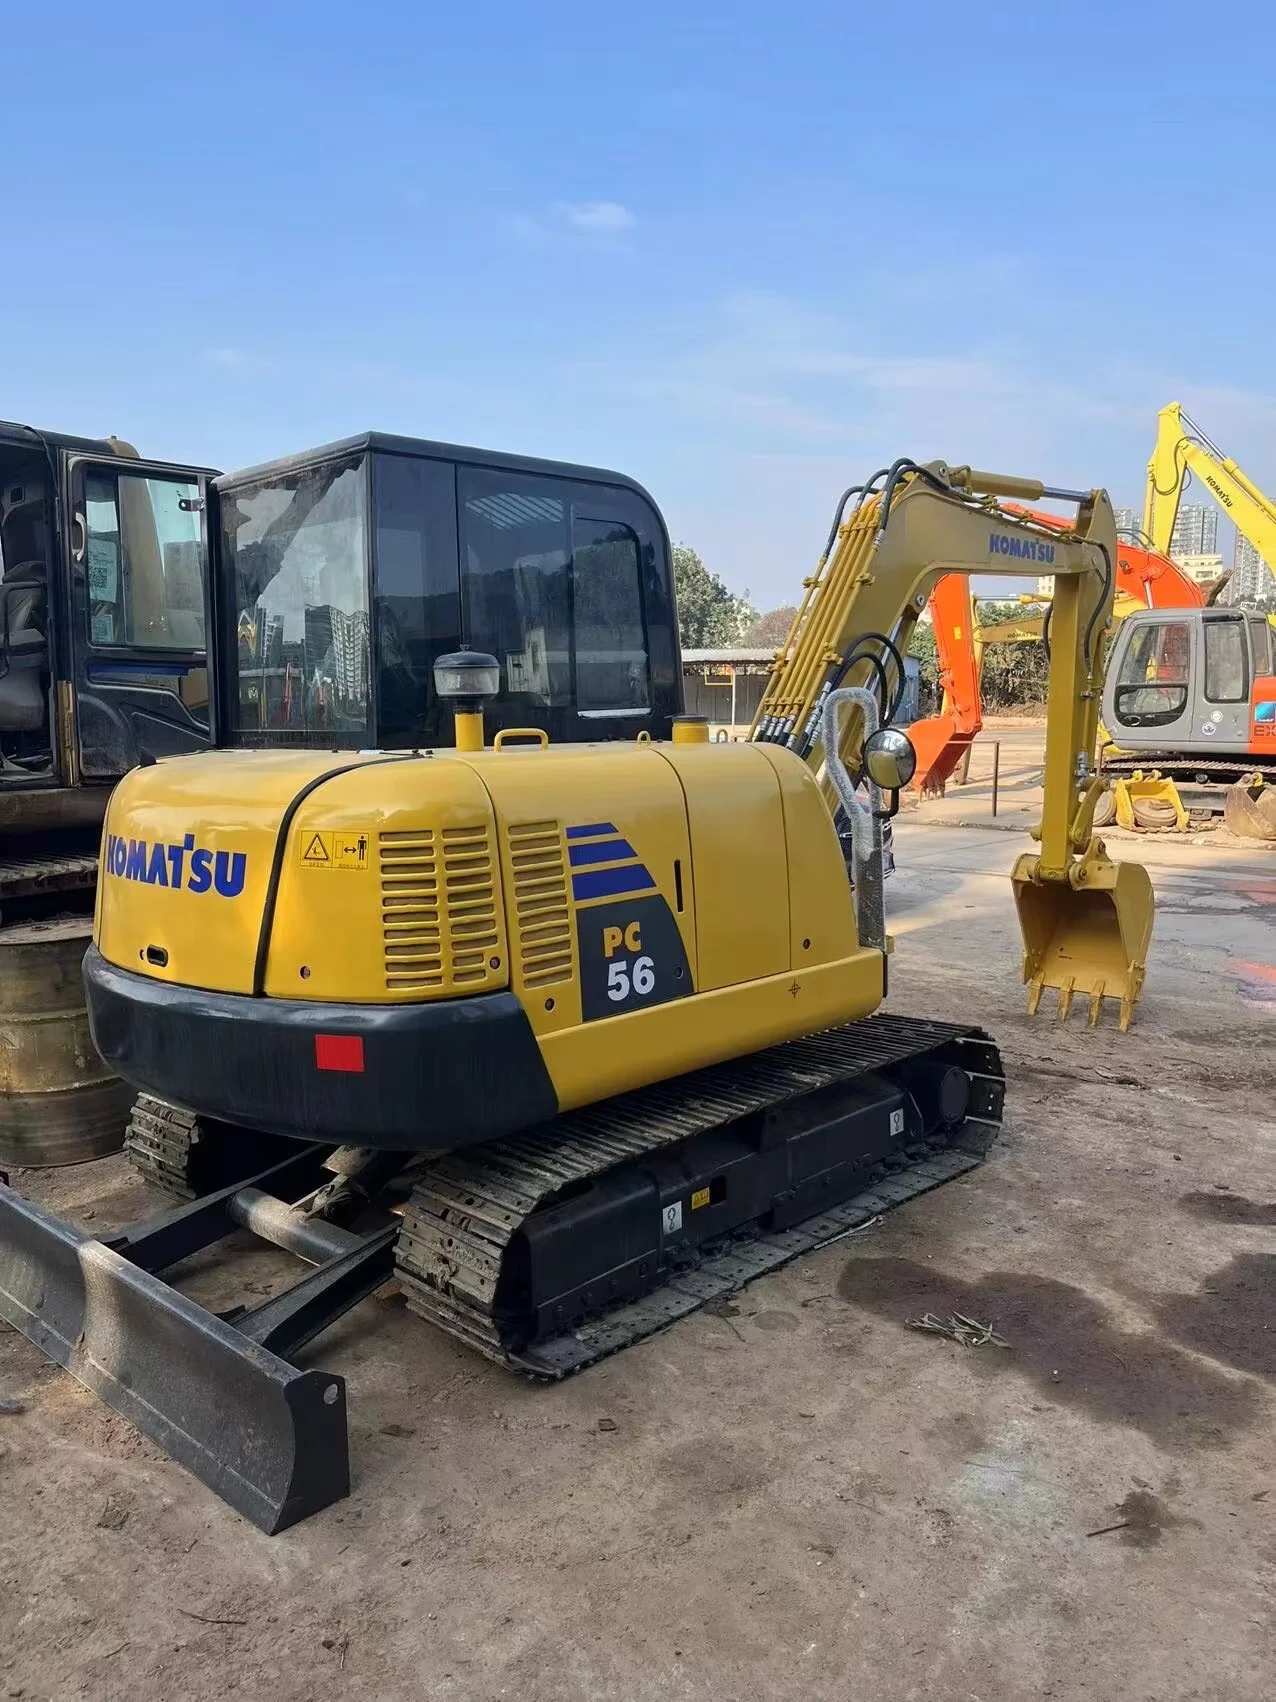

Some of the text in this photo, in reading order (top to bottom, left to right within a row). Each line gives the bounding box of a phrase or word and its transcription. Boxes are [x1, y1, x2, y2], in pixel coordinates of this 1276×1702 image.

[1206, 475, 1233, 507] KOMATSU
[989, 533, 1055, 563] KOMATSU
[107, 833, 247, 898] KOMATSU
[603, 921, 642, 957] PC
[607, 955, 655, 1001] 56
